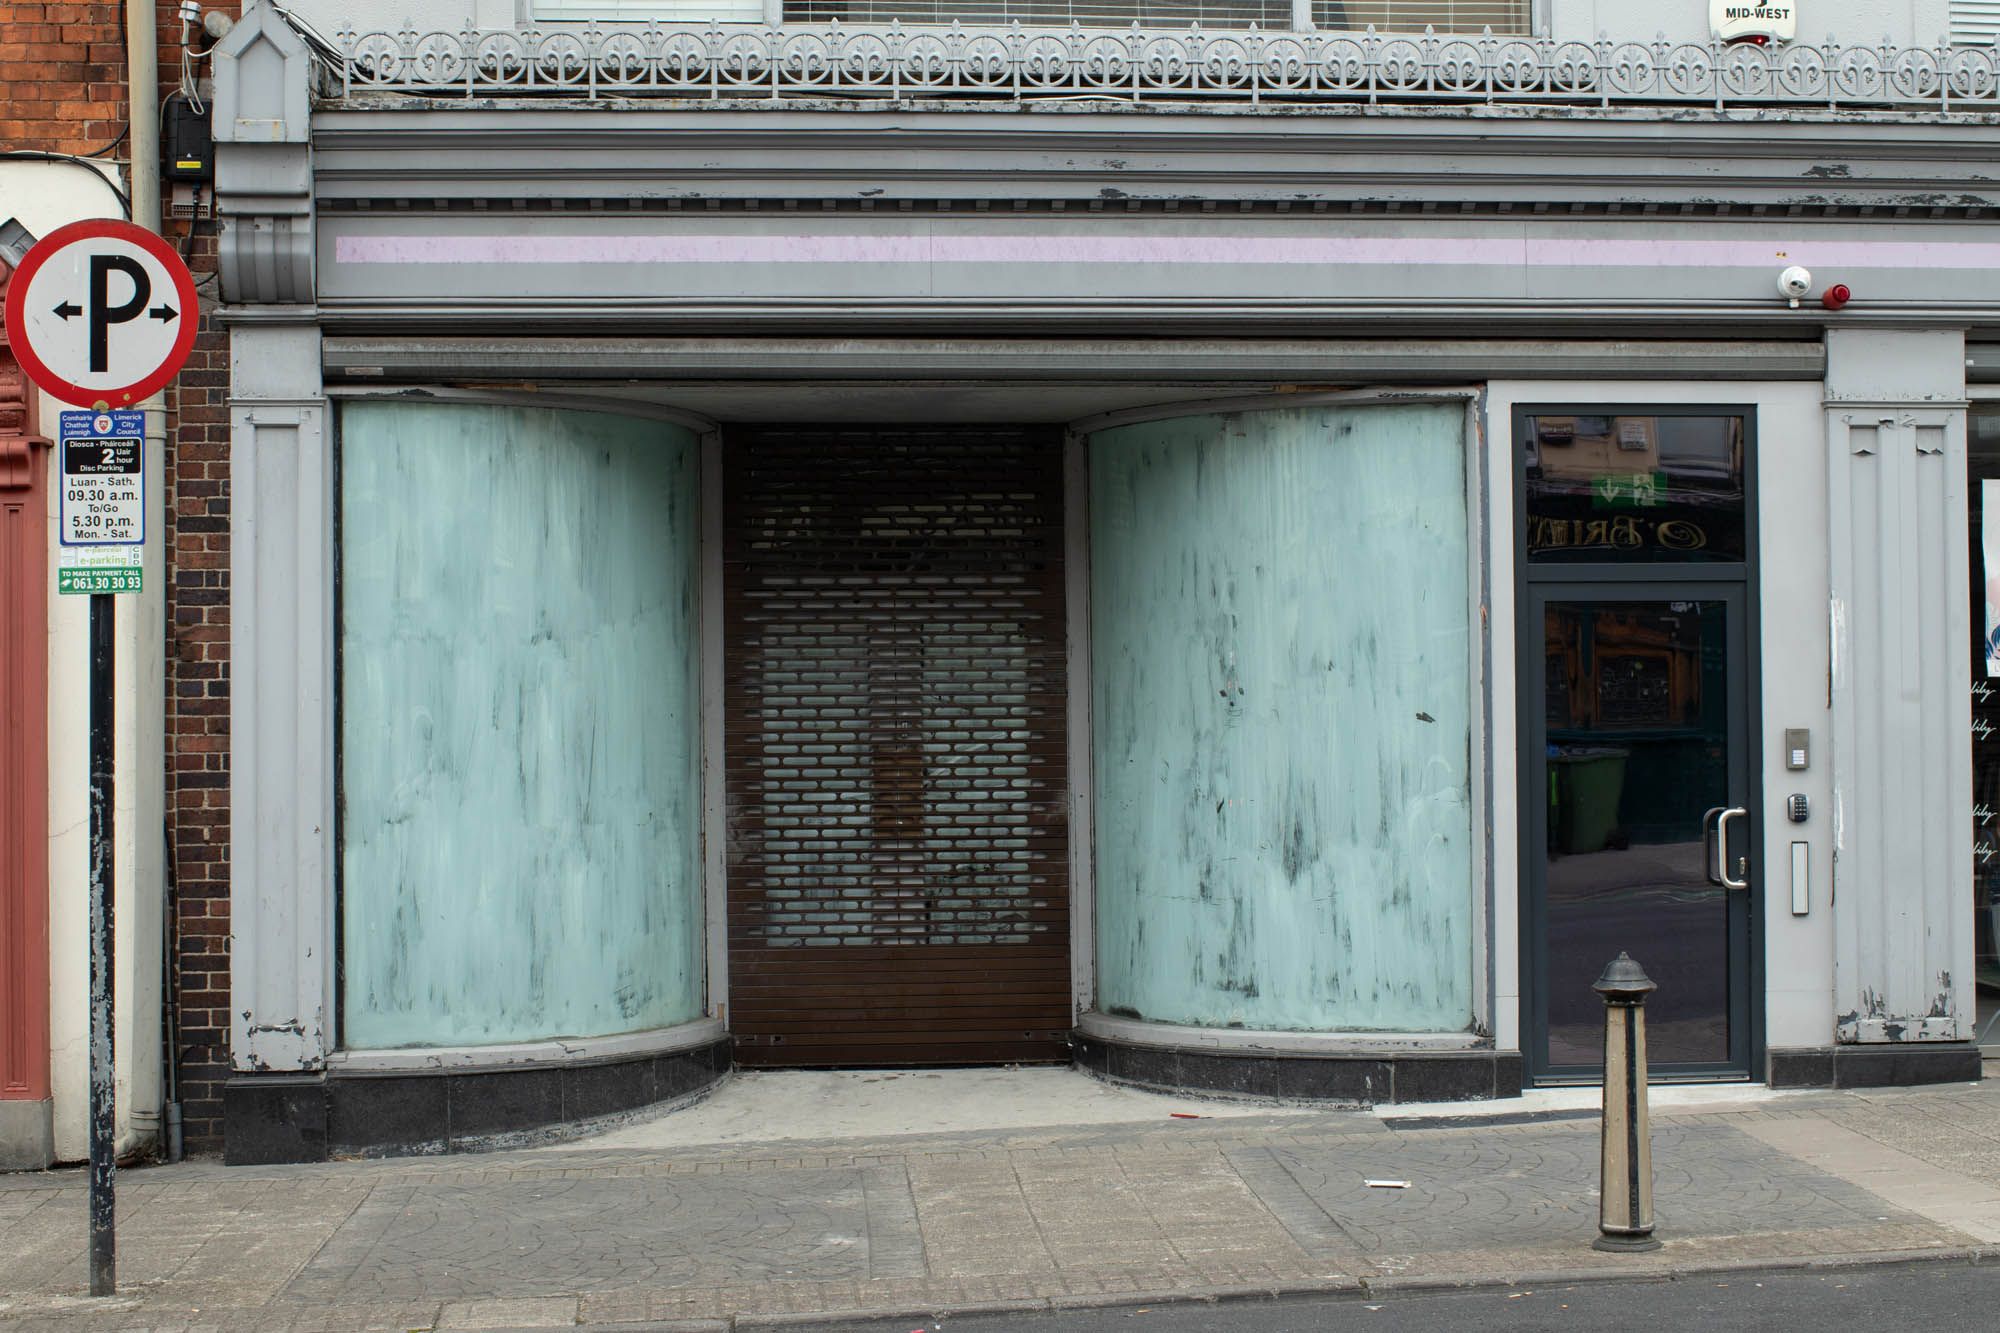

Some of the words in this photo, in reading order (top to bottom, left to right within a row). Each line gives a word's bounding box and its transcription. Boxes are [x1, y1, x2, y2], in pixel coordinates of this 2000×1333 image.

[1725, 8, 1790, 19] MID-WEST
[90, 255, 151, 373] P
[102, 448, 115, 464] 2
[70, 478, 97, 486] Luan
[107, 477, 136, 486] Sath.
[68, 490, 105, 501] 09.30
[109, 492, 138, 500] a.m.
[88, 504, 119, 512] To/Go
[72, 516, 101, 527] 5.30
[105, 517, 134, 529] p.m.
[74, 530, 100, 538] Mon.
[110, 529, 132, 538] Sat.
[80, 556, 128, 565] e-parking
[73, 578, 94, 590] 061
[96, 577, 109, 589] 30
[112, 577, 125, 588] 30
[128, 576, 141, 588] 93
